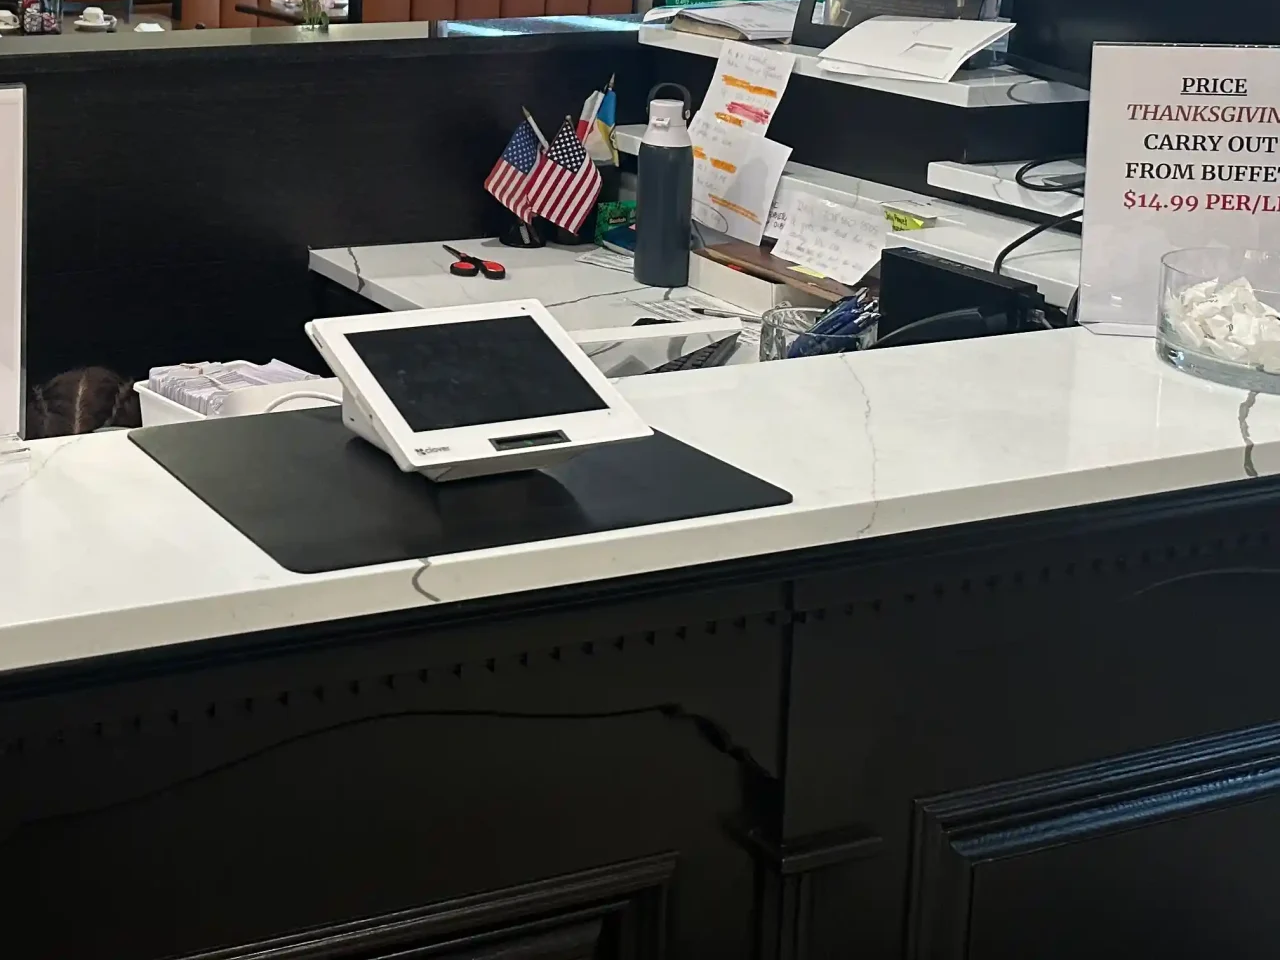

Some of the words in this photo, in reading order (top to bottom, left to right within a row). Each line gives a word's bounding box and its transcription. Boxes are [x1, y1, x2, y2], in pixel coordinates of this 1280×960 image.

[1181, 78, 1247, 96] PRICE
[1144, 134, 1223, 151] CARRY
[1228, 136, 1278, 153] OUT
[1125, 163, 1194, 180] FROM
[1201, 164, 1280, 182] BUFFE
[1124, 190, 1199, 212] $14.99
[1205, 194, 1280, 215] PER/L
